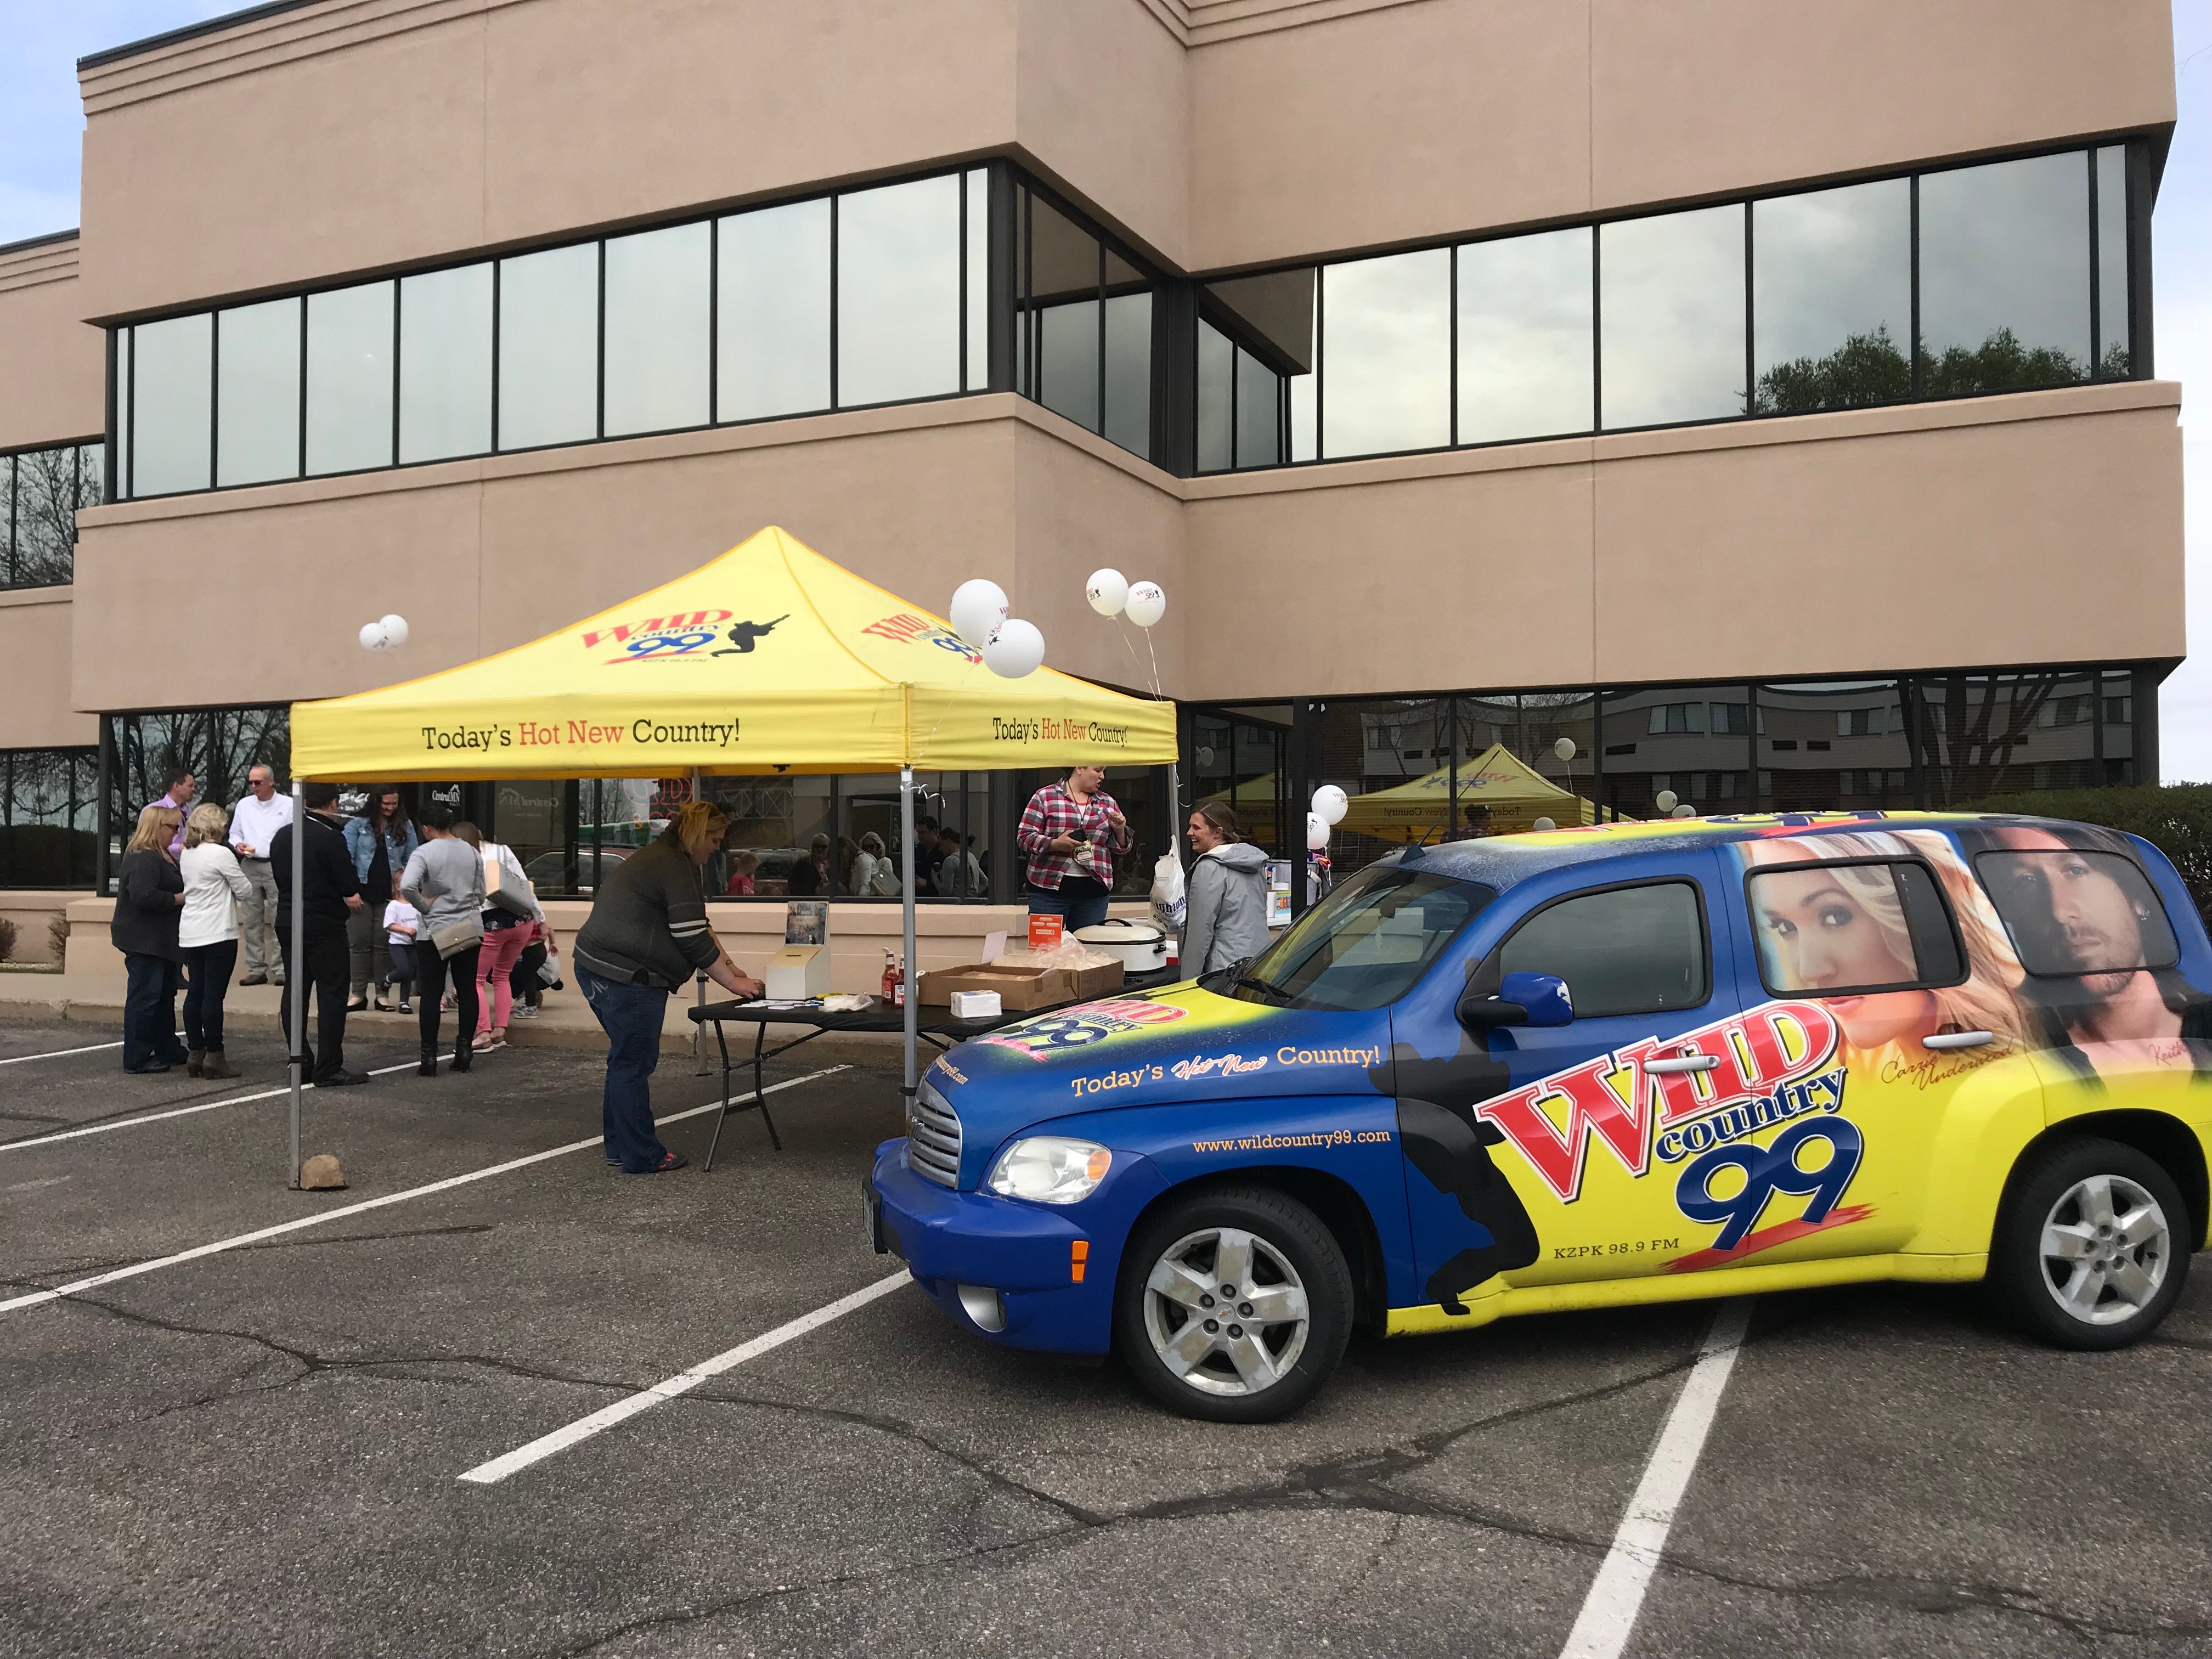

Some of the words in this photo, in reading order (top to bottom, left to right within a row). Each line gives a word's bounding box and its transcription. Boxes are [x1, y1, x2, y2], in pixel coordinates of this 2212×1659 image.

[580, 610, 733, 648] WILD
[627, 633, 716, 658] 99
[422, 724, 511, 751] Today's
[519, 721, 560, 746] Hot
[568, 720, 624, 744] New
[633, 718, 740, 747] Country!
[992, 717, 1039, 744] Today's
[1041, 718, 1060, 740] Hot
[1063, 719, 1086, 740] New
[1088, 721, 1128, 747] Country!
[2148, 1041, 2187, 1066] Keith
[1071, 1063, 1164, 1097] Today's
[1171, 1054, 1211, 1079] Hot
[1214, 1052, 1268, 1077] New
[1277, 1044, 1380, 1068] Country!
[1472, 1000, 1841, 1204] WILD
[1656, 1065, 1848, 1163] country
[1193, 1130, 1391, 1154] www.wildcountry99.com
[1674, 1115, 1865, 1251] 99
[1554, 1246, 1604, 1259] KZPK
[1609, 1243, 1645, 1256] 98.9
[1651, 1239, 1679, 1252] FM
